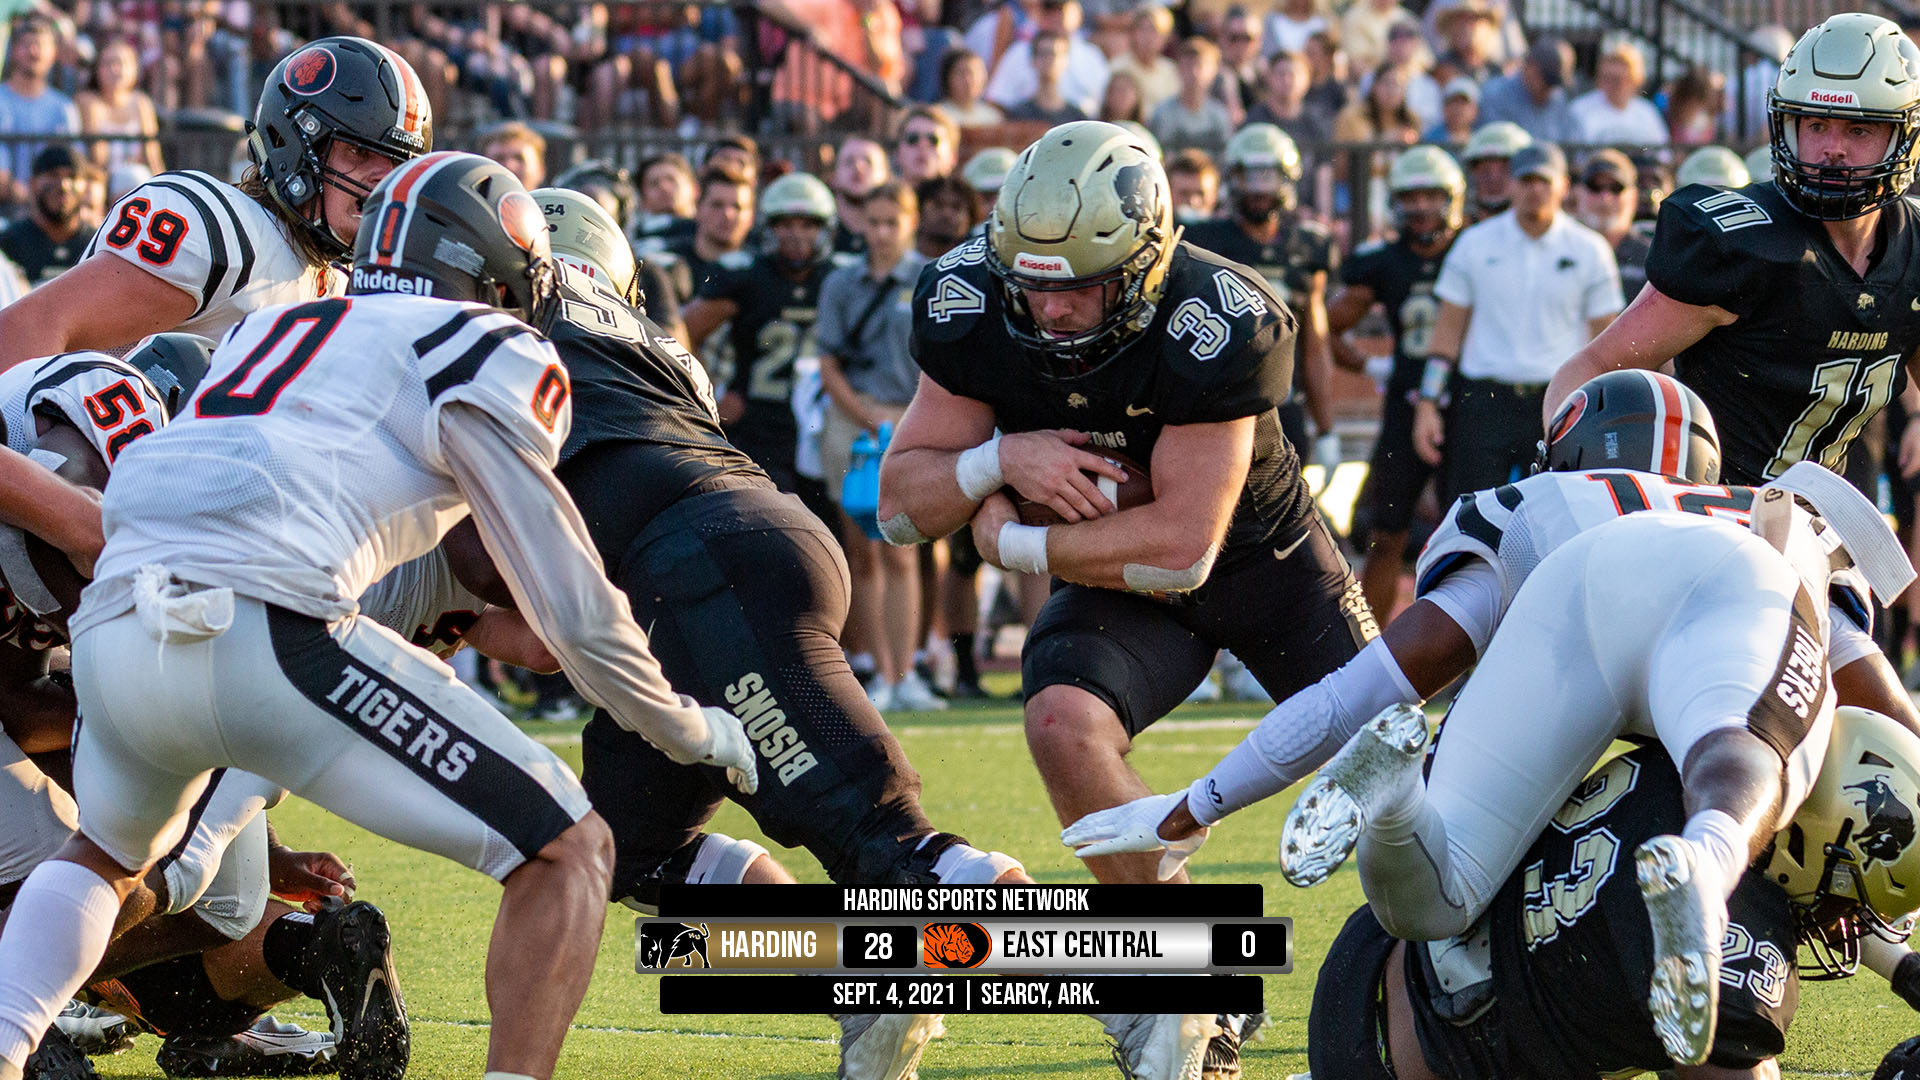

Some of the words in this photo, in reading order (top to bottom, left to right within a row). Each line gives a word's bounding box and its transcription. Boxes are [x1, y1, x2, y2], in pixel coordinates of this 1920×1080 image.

[1811, 92, 1853, 104] Riddell
[106, 197, 190, 266] 69
[544, 204, 565, 216] 54
[1693, 190, 1774, 232] 11
[354, 268, 434, 297] Riddell
[1019, 258, 1062, 271] Riddell
[1167, 269, 1268, 361] 34
[1827, 331, 1889, 350] HARDING
[194, 297, 353, 419] 0
[531, 363, 571, 434] 0
[1762, 354, 1901, 480] 11
[1776, 625, 1824, 718] TIGERS
[325, 665, 477, 782] TIGERS
[724, 672, 818, 787] BISONS
